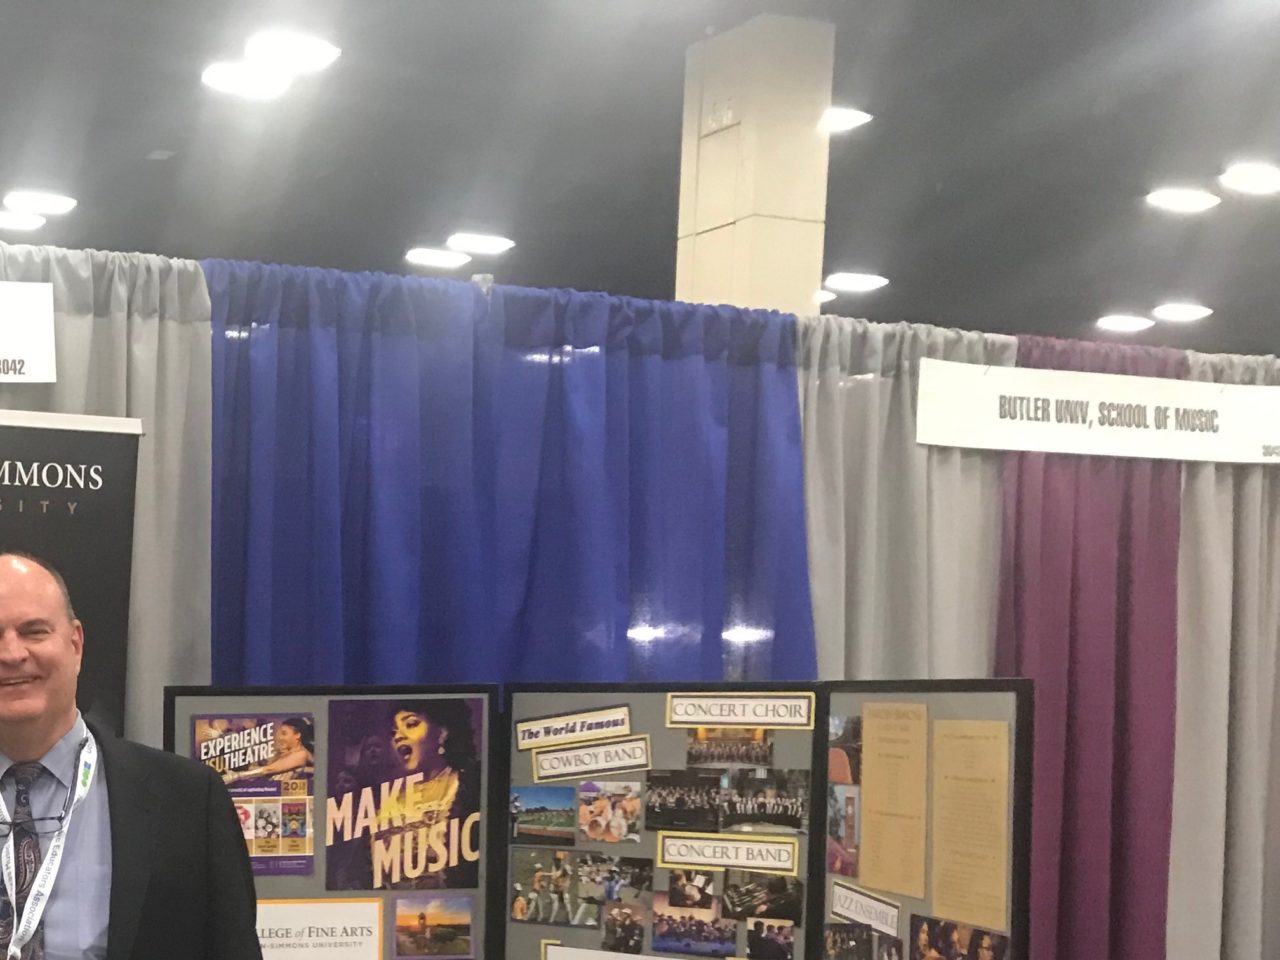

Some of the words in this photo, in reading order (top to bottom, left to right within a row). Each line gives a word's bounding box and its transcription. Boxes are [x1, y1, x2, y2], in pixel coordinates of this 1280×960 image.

[999, 395, 1051, 423] BUTLER
[1098, 402, 1149, 429] SCHOOL
[1154, 406, 1171, 431] OF
[1175, 408, 1219, 433] MUSIC
[673, 702, 748, 717] CONCERT
[753, 703, 806, 719] CHOIR
[201, 722, 274, 760] EXPERIENCE
[543, 723, 578, 738] World
[580, 716, 626, 733] Famous
[224, 741, 275, 769] THEATRE
[539, 750, 600, 770] COWBOY
[604, 746, 645, 762] BAND
[326, 772, 424, 847] MAKE
[37, 838, 63, 889] Educators
[373, 811, 480, 889] MUSIC
[666, 844, 742, 860] CONCERT
[746, 846, 791, 863] BAND
[17, 889, 45, 942] Association
[258, 927, 292, 939] LEGE
[294, 926, 306, 940] of
[308, 926, 337, 938] FINE
[340, 925, 373, 937] ARTS
[260, 942, 309, 950] N-SIMMONS
[312, 941, 363, 949] UNIVERSITY
